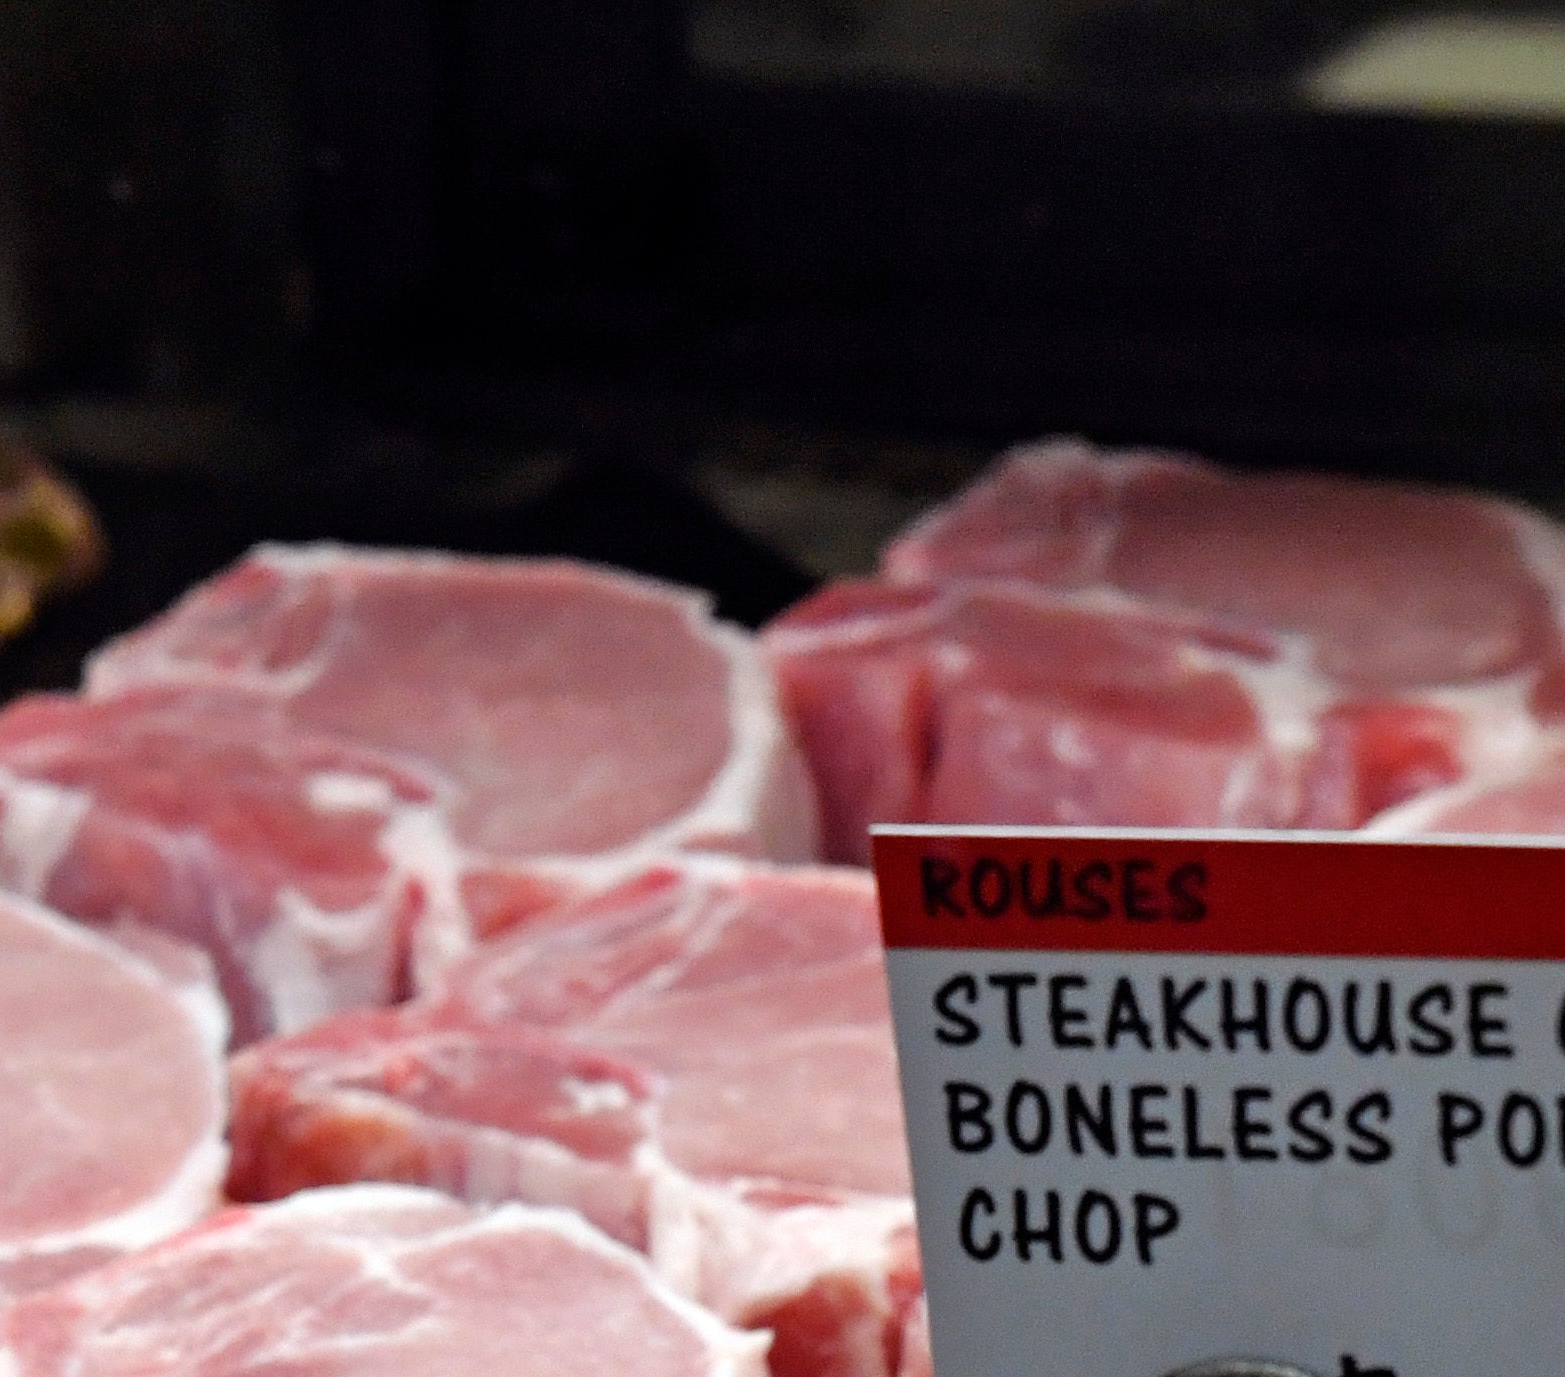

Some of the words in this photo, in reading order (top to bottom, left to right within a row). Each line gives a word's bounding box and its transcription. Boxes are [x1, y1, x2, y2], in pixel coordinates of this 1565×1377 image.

[920, 855, 1209, 924] ROUSES
[932, 972, 1515, 1060] STEAKHOUSE
[943, 1080, 1394, 1166] BONELESS
[959, 1187, 1181, 1266] CHOP
